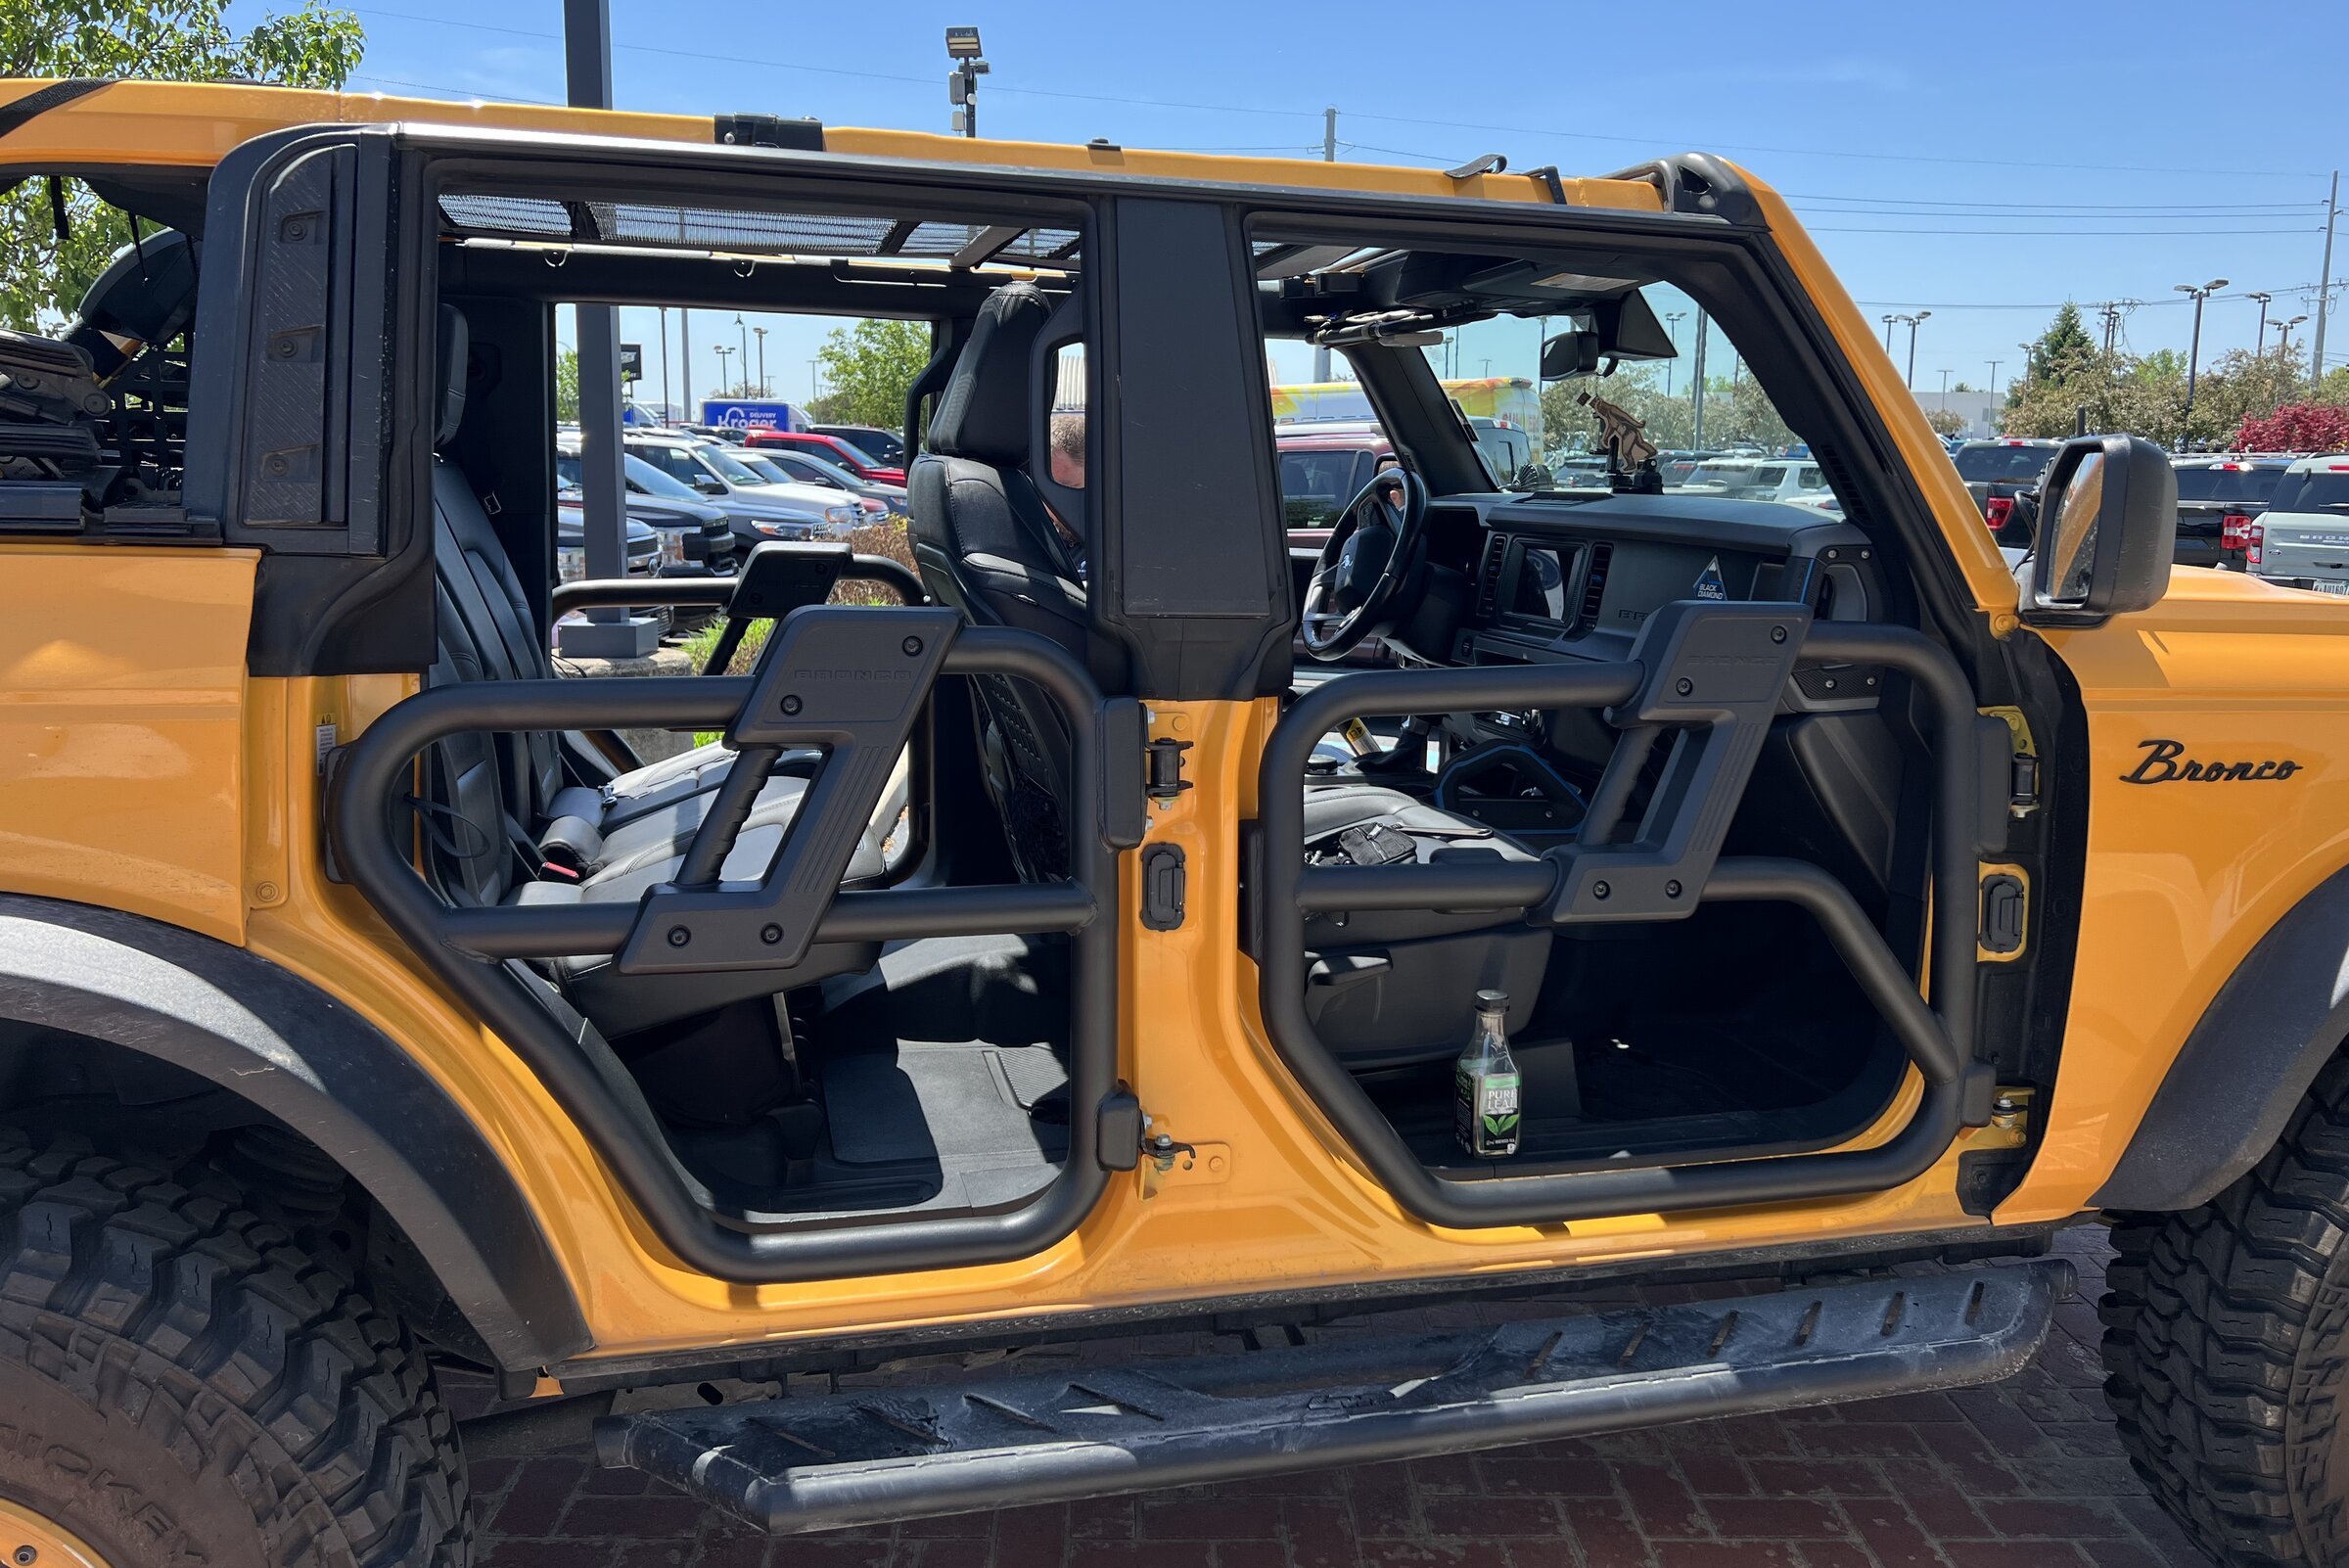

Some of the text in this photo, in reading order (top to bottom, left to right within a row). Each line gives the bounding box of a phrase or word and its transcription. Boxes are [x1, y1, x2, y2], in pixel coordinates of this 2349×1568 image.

[717, 407, 777, 429] Kroger
[1699, 583, 1718, 592] BLACK
[1697, 590, 1724, 600] DIAMOND
[794, 669, 912, 682] BRONCO
[2119, 739, 2304, 784] Bronco
